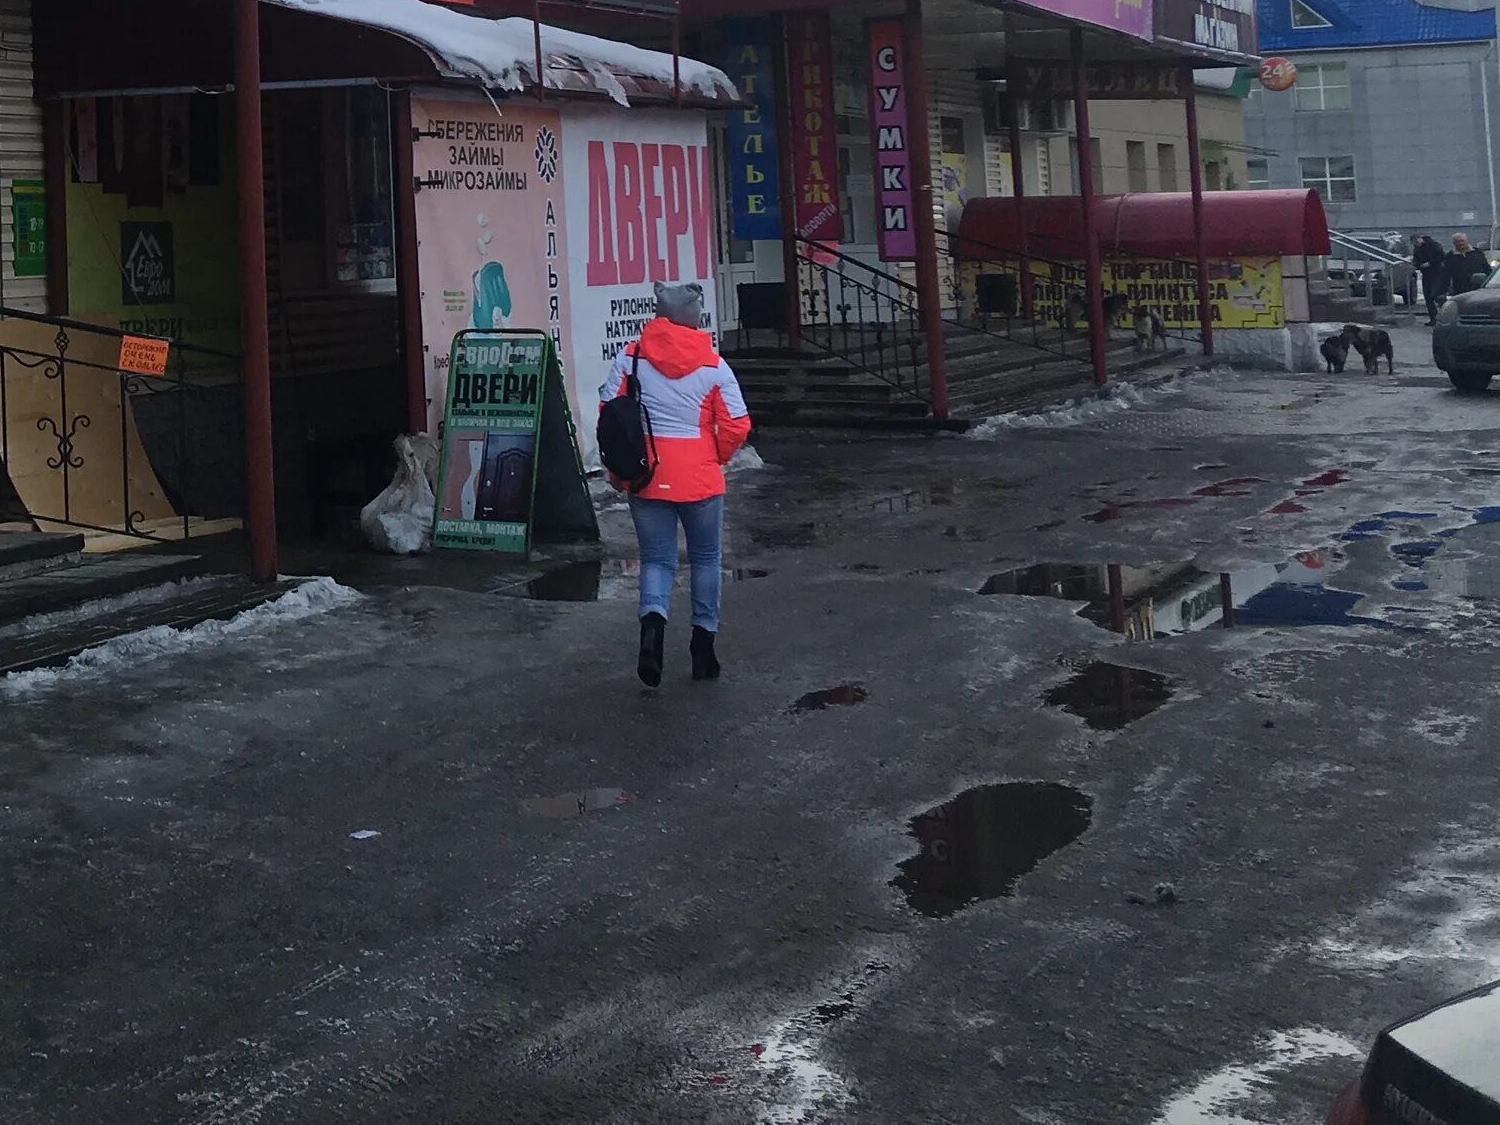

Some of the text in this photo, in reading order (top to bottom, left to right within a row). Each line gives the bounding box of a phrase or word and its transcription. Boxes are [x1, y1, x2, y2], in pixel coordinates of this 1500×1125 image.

[428, 119, 524, 143] СБЕРЕЖЕНИЯ
[739, 44, 767, 214] АТЕЛЬЕ
[877, 46, 907, 232] СУМКИ
[448, 142, 505, 167] ЗАЙМЫ
[427, 166, 528, 191] МИКРОЗАЙМЫ
[586, 140, 716, 287] ДВЕРИ
[452, 373, 538, 408] ДВЕРИ
